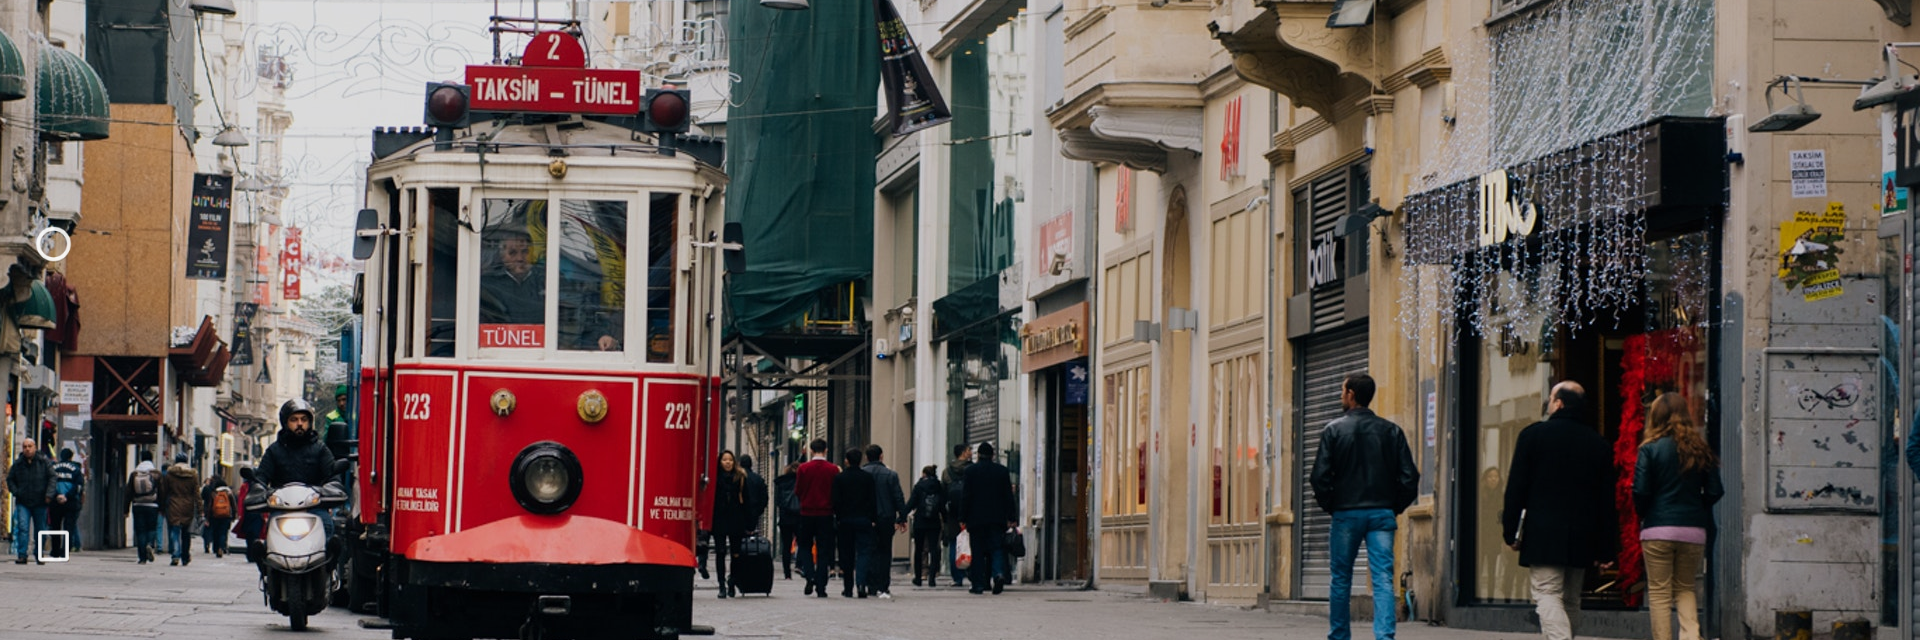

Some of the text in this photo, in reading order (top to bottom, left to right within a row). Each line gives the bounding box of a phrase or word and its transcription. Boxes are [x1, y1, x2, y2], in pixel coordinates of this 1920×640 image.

[547, 34, 560, 60] 2
[474, 75, 540, 102] TAKSİM
[572, 77, 634, 105] TÜNEL
[286, 241, 300, 288] CHP
[483, 328, 540, 346] TÜNEL
[403, 393, 431, 420] 223
[665, 402, 691, 430] 223
[650, 509, 661, 519] VE
